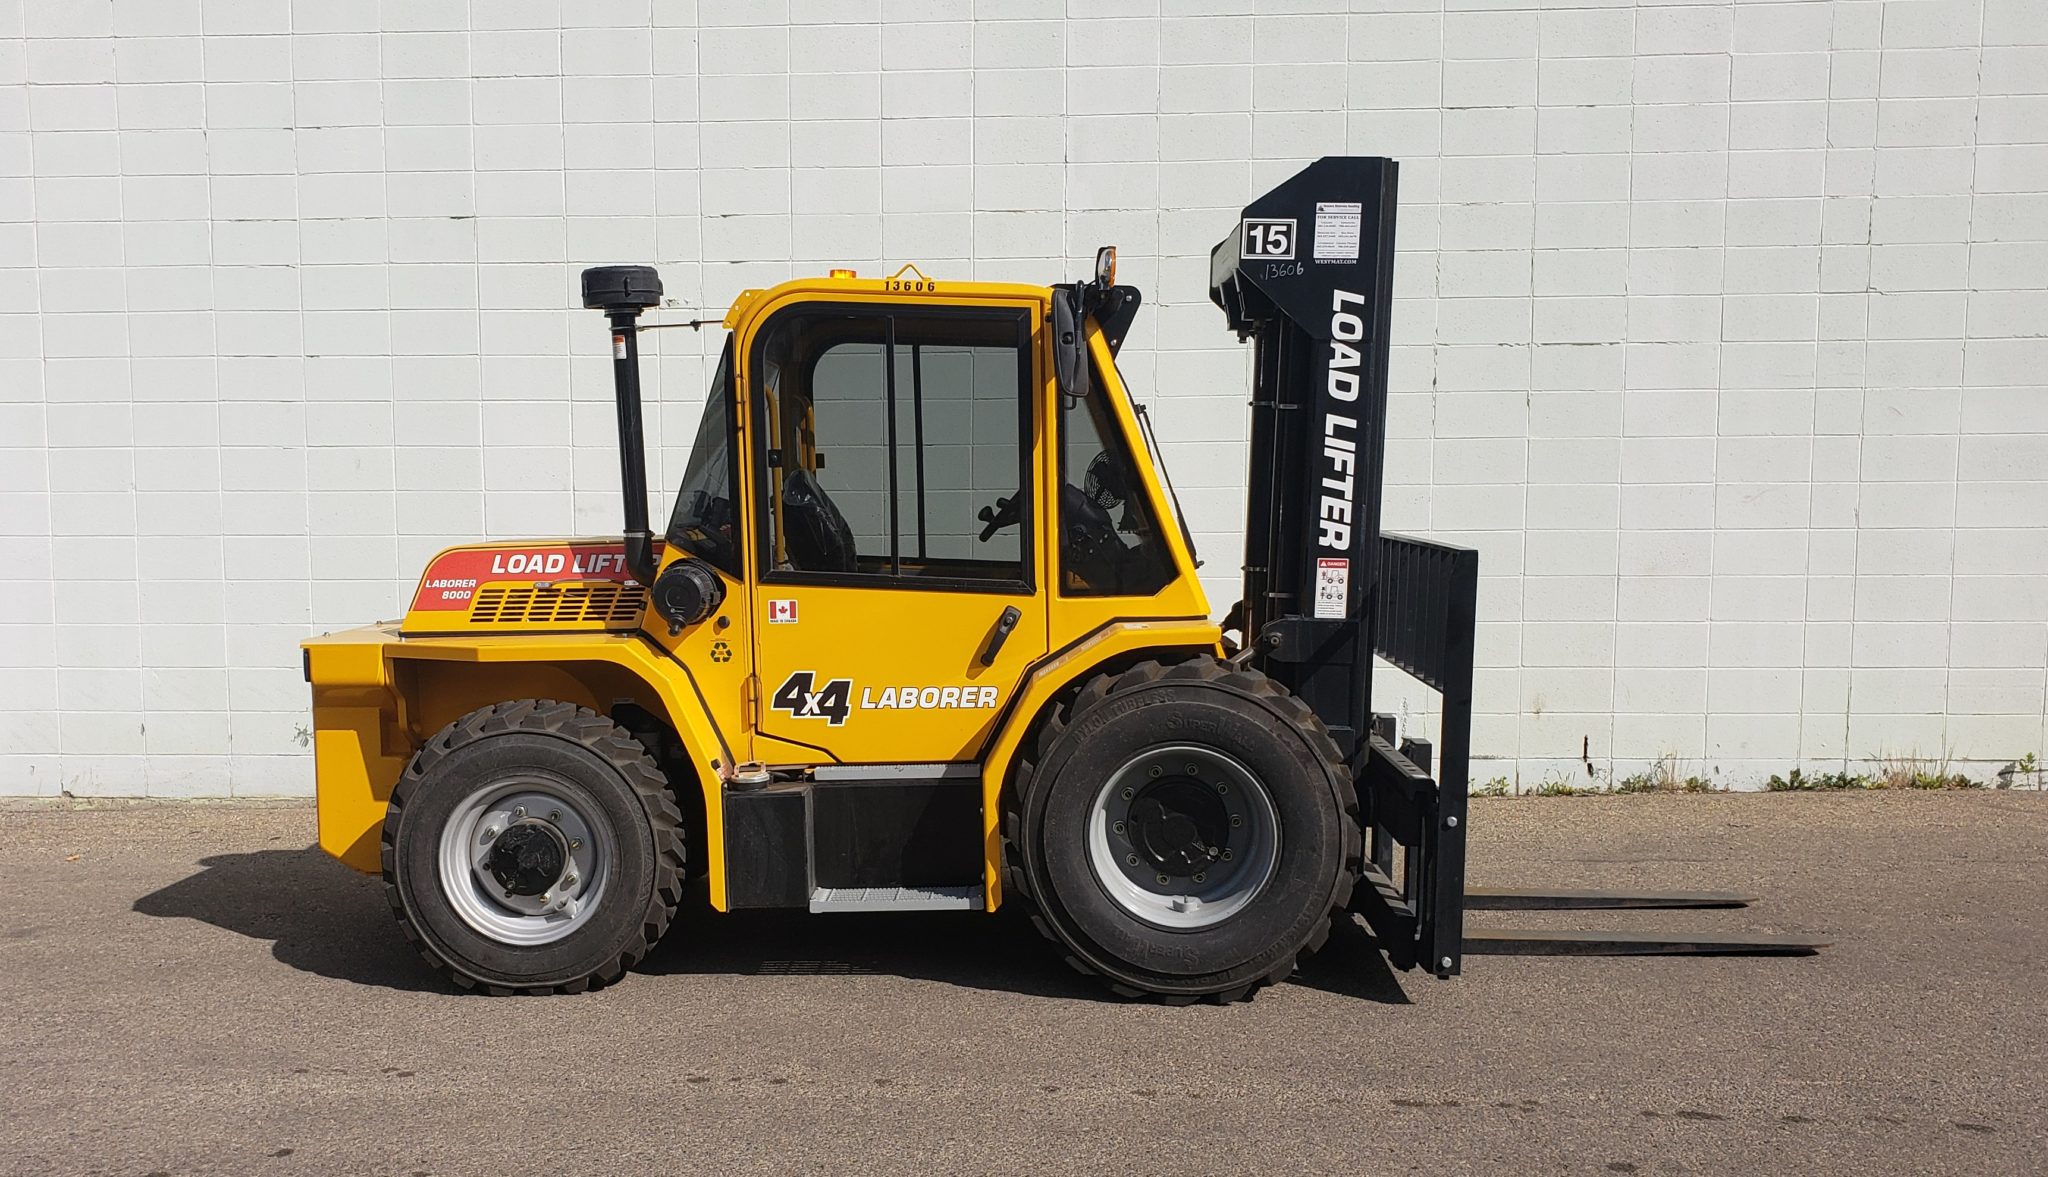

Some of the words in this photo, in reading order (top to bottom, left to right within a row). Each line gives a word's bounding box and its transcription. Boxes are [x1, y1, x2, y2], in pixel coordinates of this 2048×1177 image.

[1249, 224, 1289, 255] 15
[1265, 262, 1304, 280] 13606
[884, 280, 936, 292] 13606
[1327, 288, 1365, 403] LOAD
[1318, 413, 1357, 551] LIFTER
[491, 553, 565, 574] LOAD
[425, 579, 477, 588] LABORER
[441, 591, 472, 600] 8000
[771, 671, 853, 727] 4x4
[860, 686, 998, 709] LABORER
